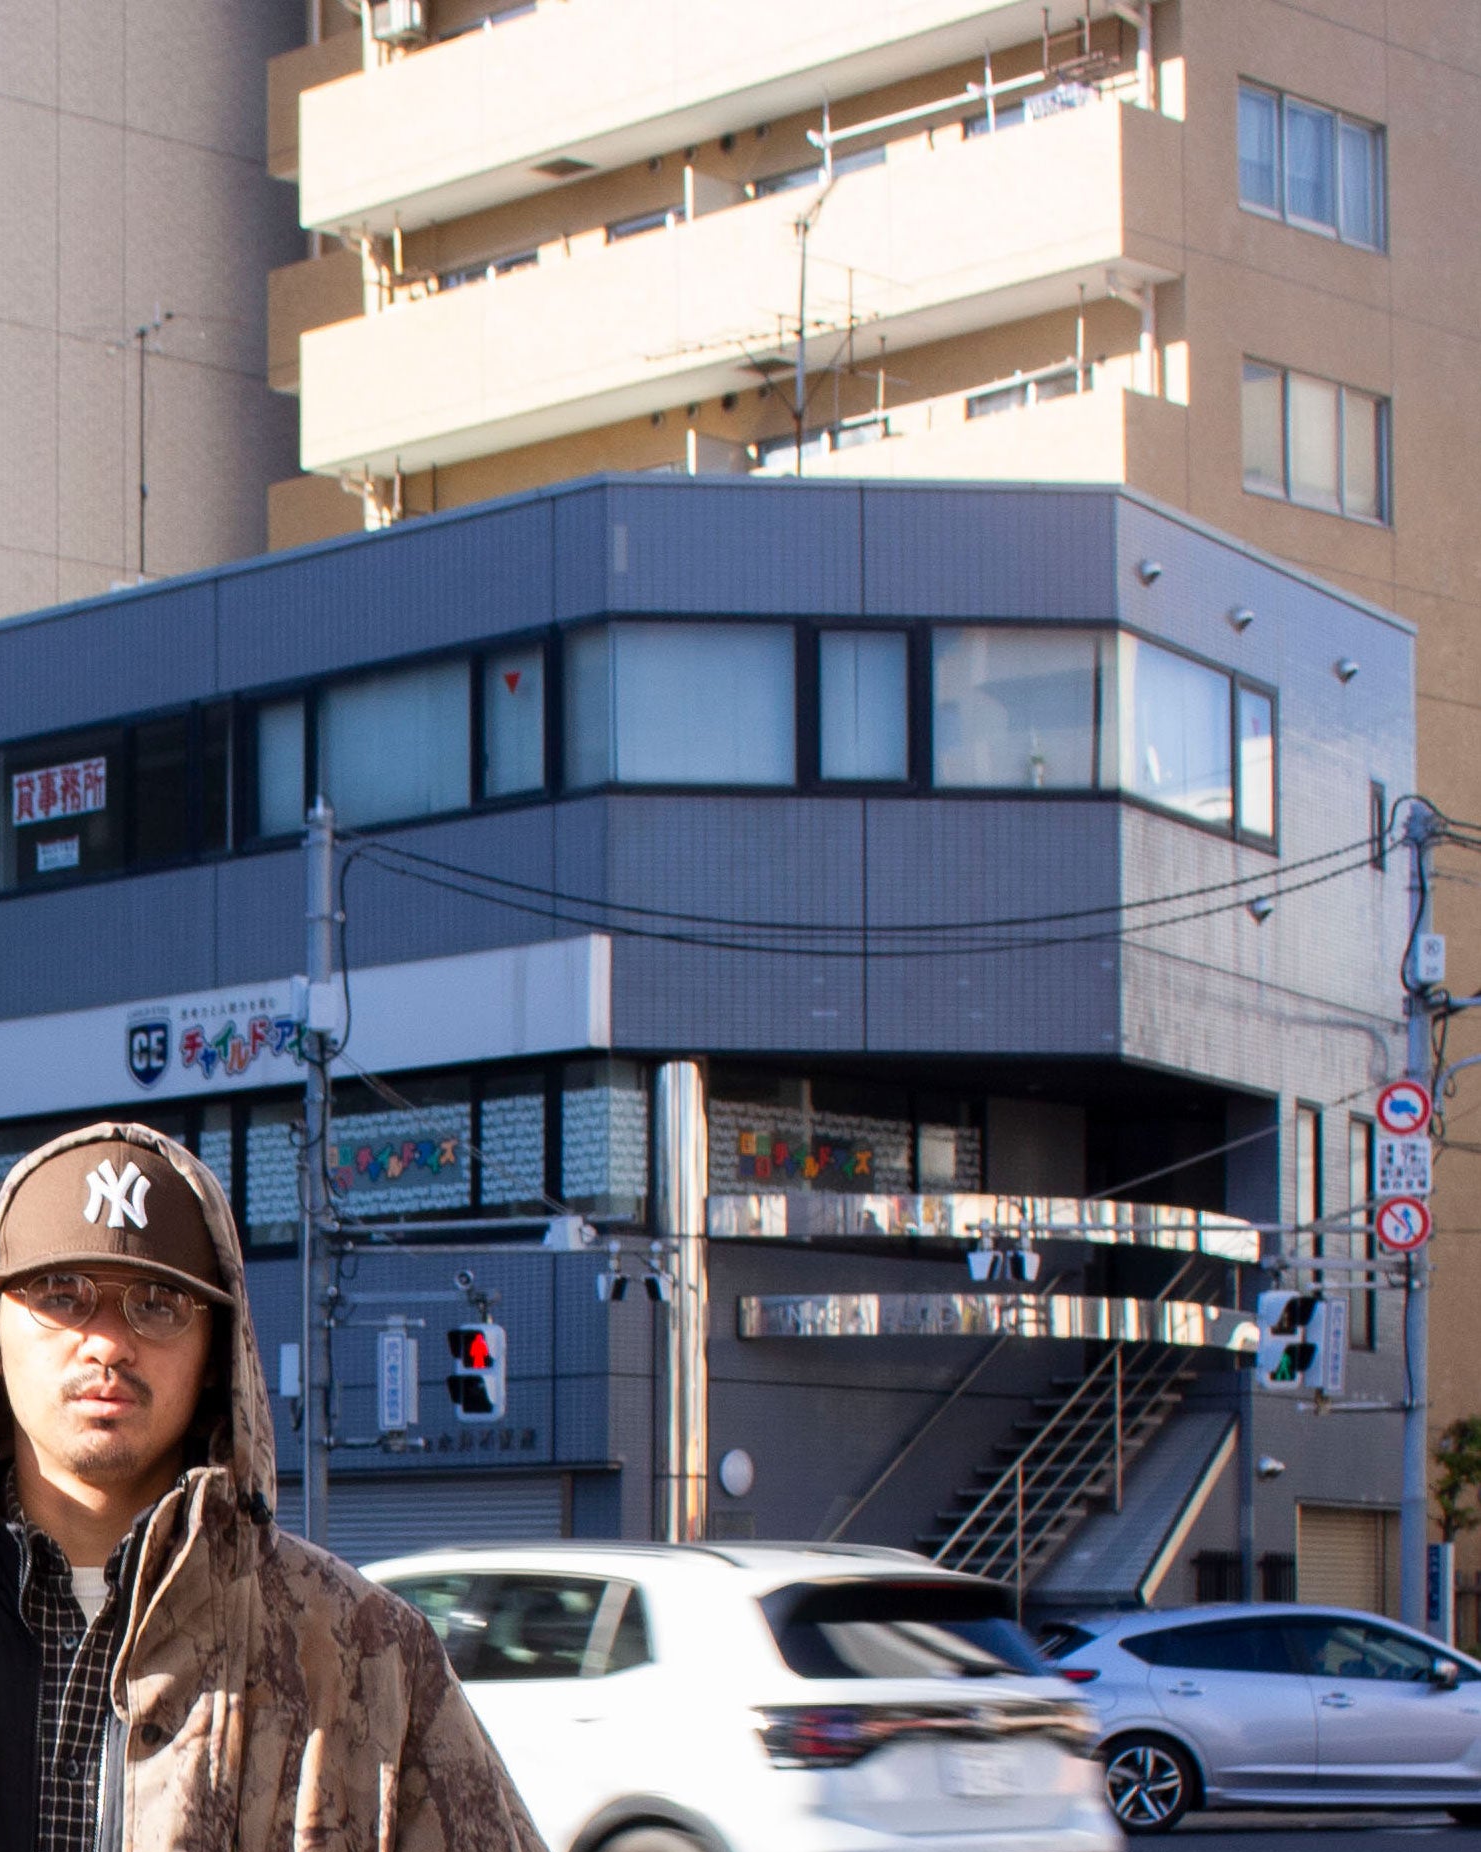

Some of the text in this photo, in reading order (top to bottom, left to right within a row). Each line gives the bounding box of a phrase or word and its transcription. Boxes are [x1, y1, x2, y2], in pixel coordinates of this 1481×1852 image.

[15, 762, 105, 821] 貸事務所
[131, 1028, 166, 1072] CE
[182, 1018, 308, 1078] チャイルド・アイ
[83, 1158, 151, 1229] NY
